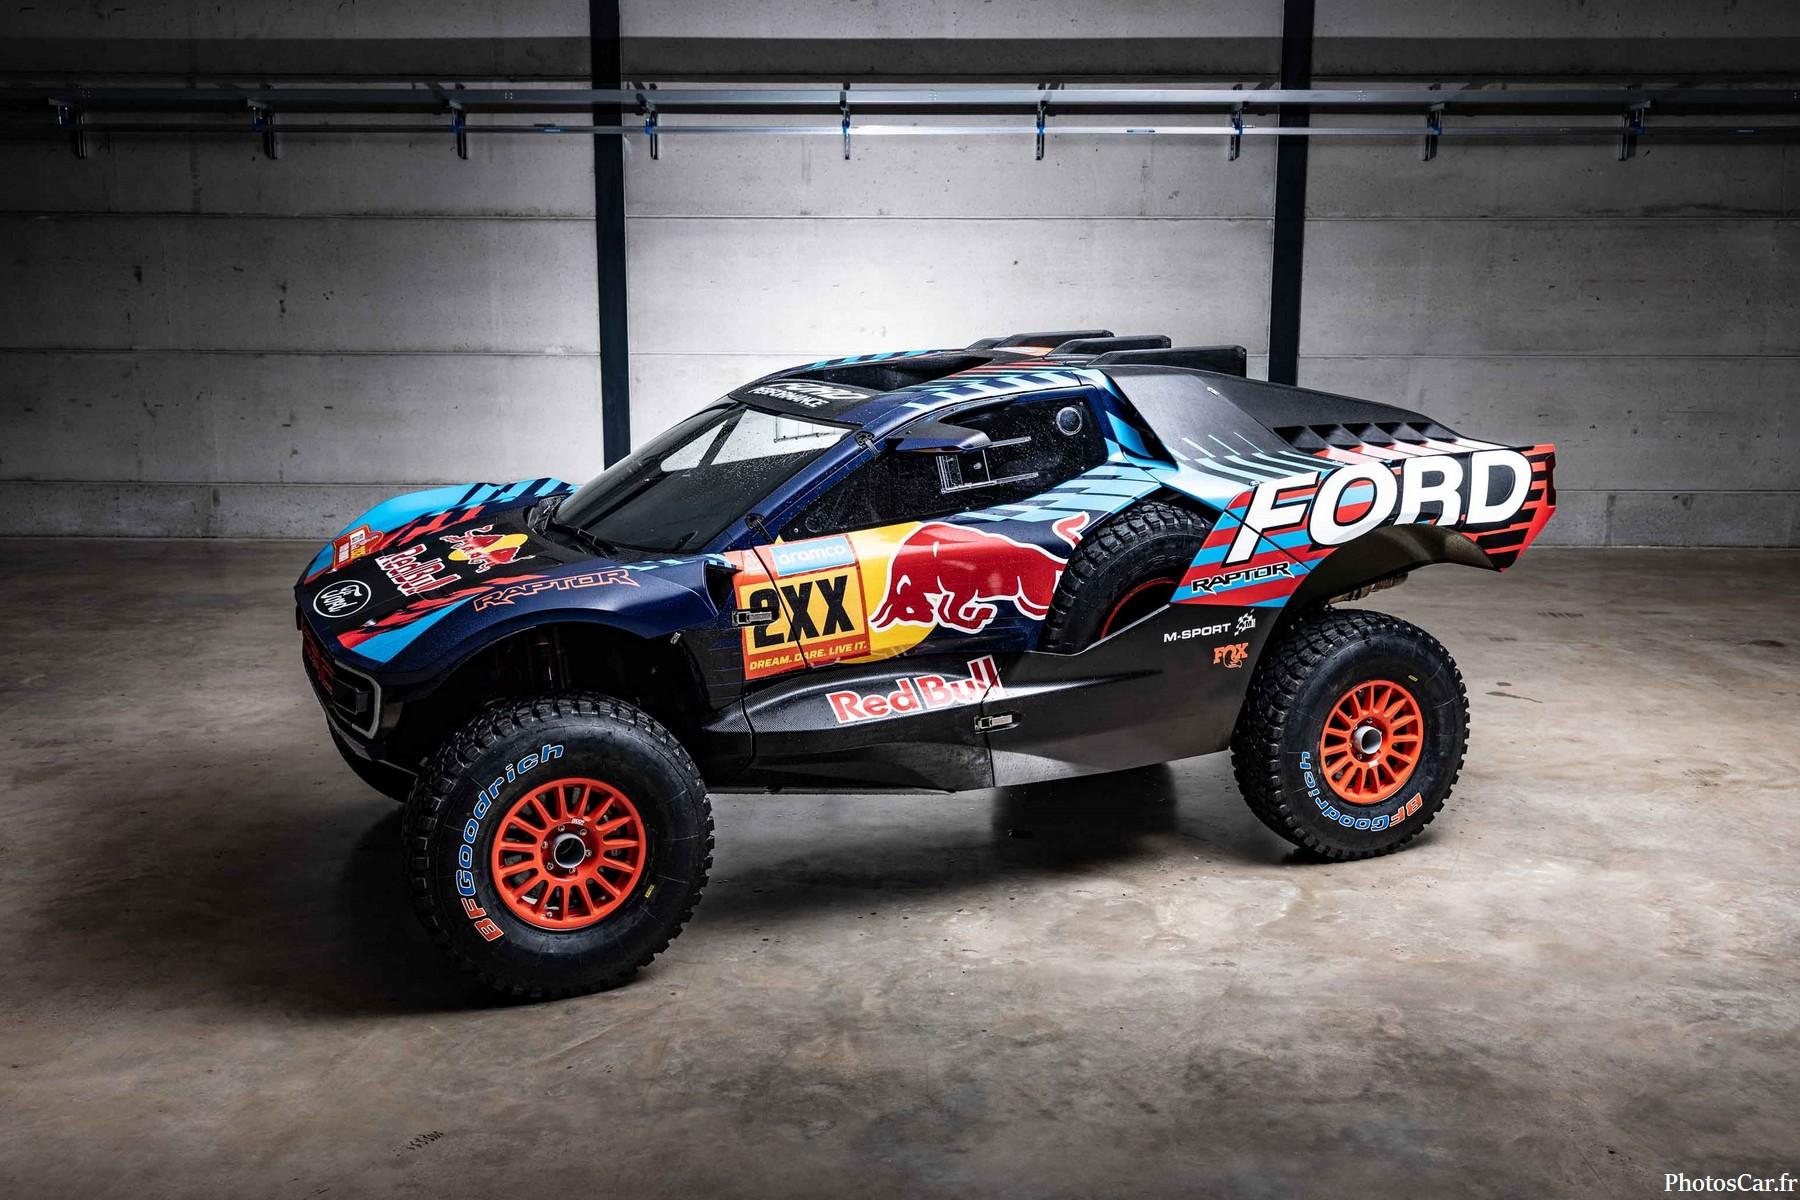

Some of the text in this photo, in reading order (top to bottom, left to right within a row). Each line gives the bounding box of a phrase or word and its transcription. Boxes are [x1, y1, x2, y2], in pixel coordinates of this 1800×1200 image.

[1222, 449, 1532, 566] FORD
[375, 544, 442, 579] Red
[780, 545, 846, 565] aramco
[391, 562, 462, 597] Bull
[474, 569, 640, 612] RAPTOR
[1191, 562, 1295, 594] RAPTOR
[321, 585, 362, 612] Ford
[749, 575, 855, 648] 2XX
[1163, 622, 1231, 642] M-SPORT
[749, 640, 867, 671] DREAM. DARE. LIVE IT.
[1213, 642, 1249, 669] FOX
[825, 654, 1003, 724] Red Bull
[1299, 751, 1424, 832] BFGoodrich
[456, 744, 564, 942] BFGoodrich
